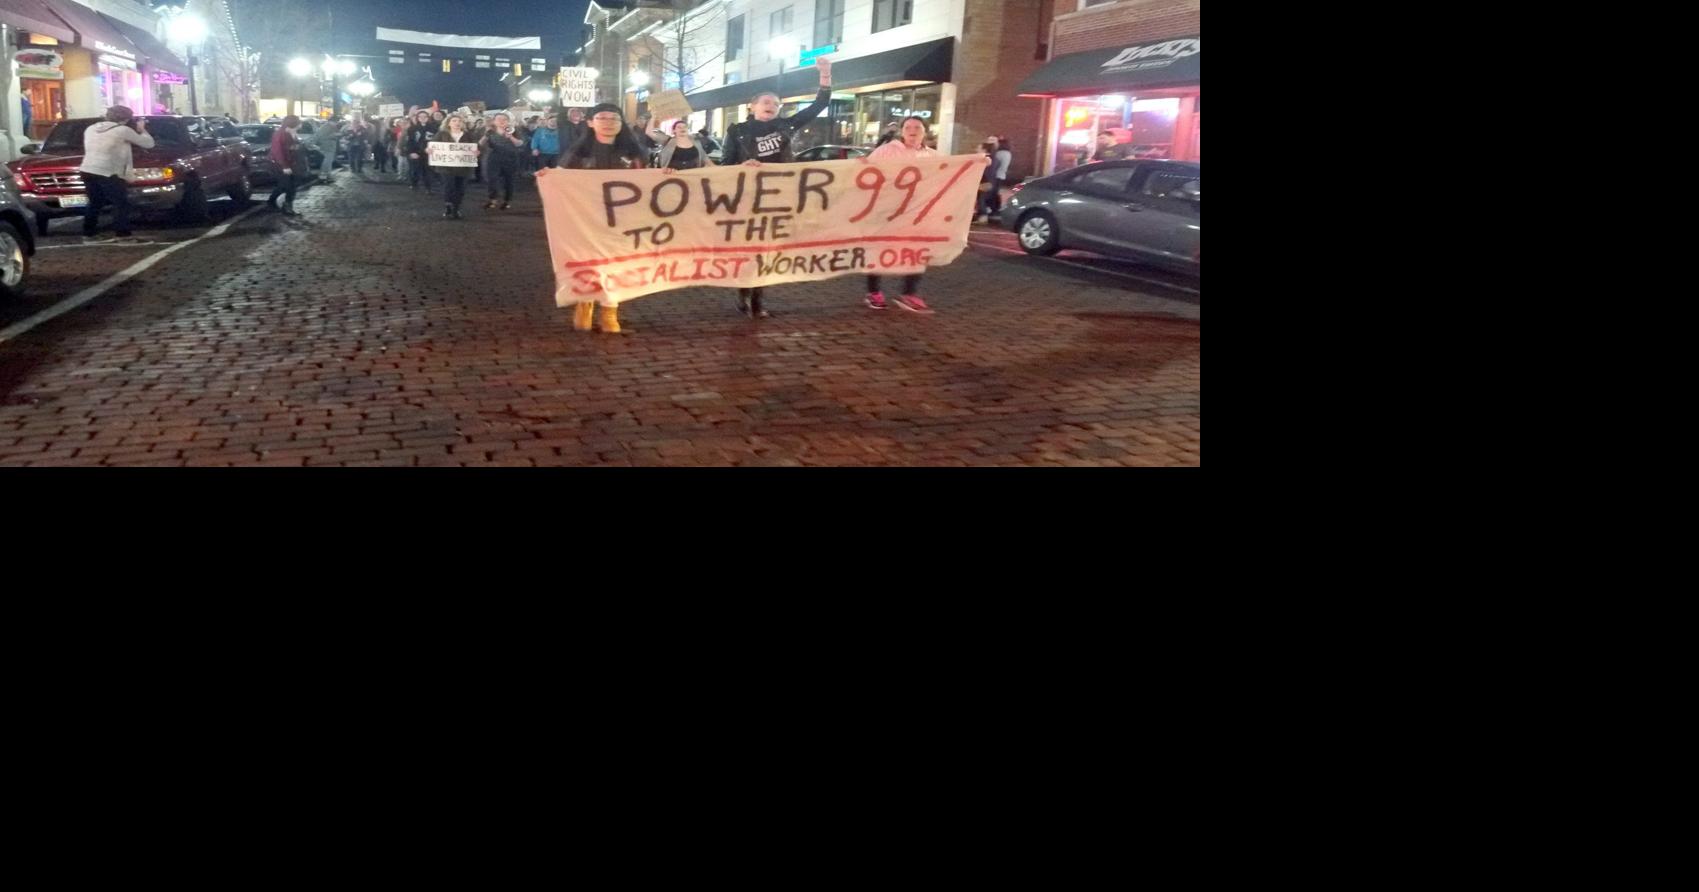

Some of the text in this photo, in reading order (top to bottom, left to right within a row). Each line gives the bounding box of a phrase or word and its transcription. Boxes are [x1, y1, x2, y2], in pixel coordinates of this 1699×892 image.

[562, 69, 587, 79] CIVIL
[560, 79, 594, 90] RIGHTS
[563, 90, 592, 103] NOW
[602, 159, 974, 227] POWER 99%
[624, 216, 793, 249] TO THE
